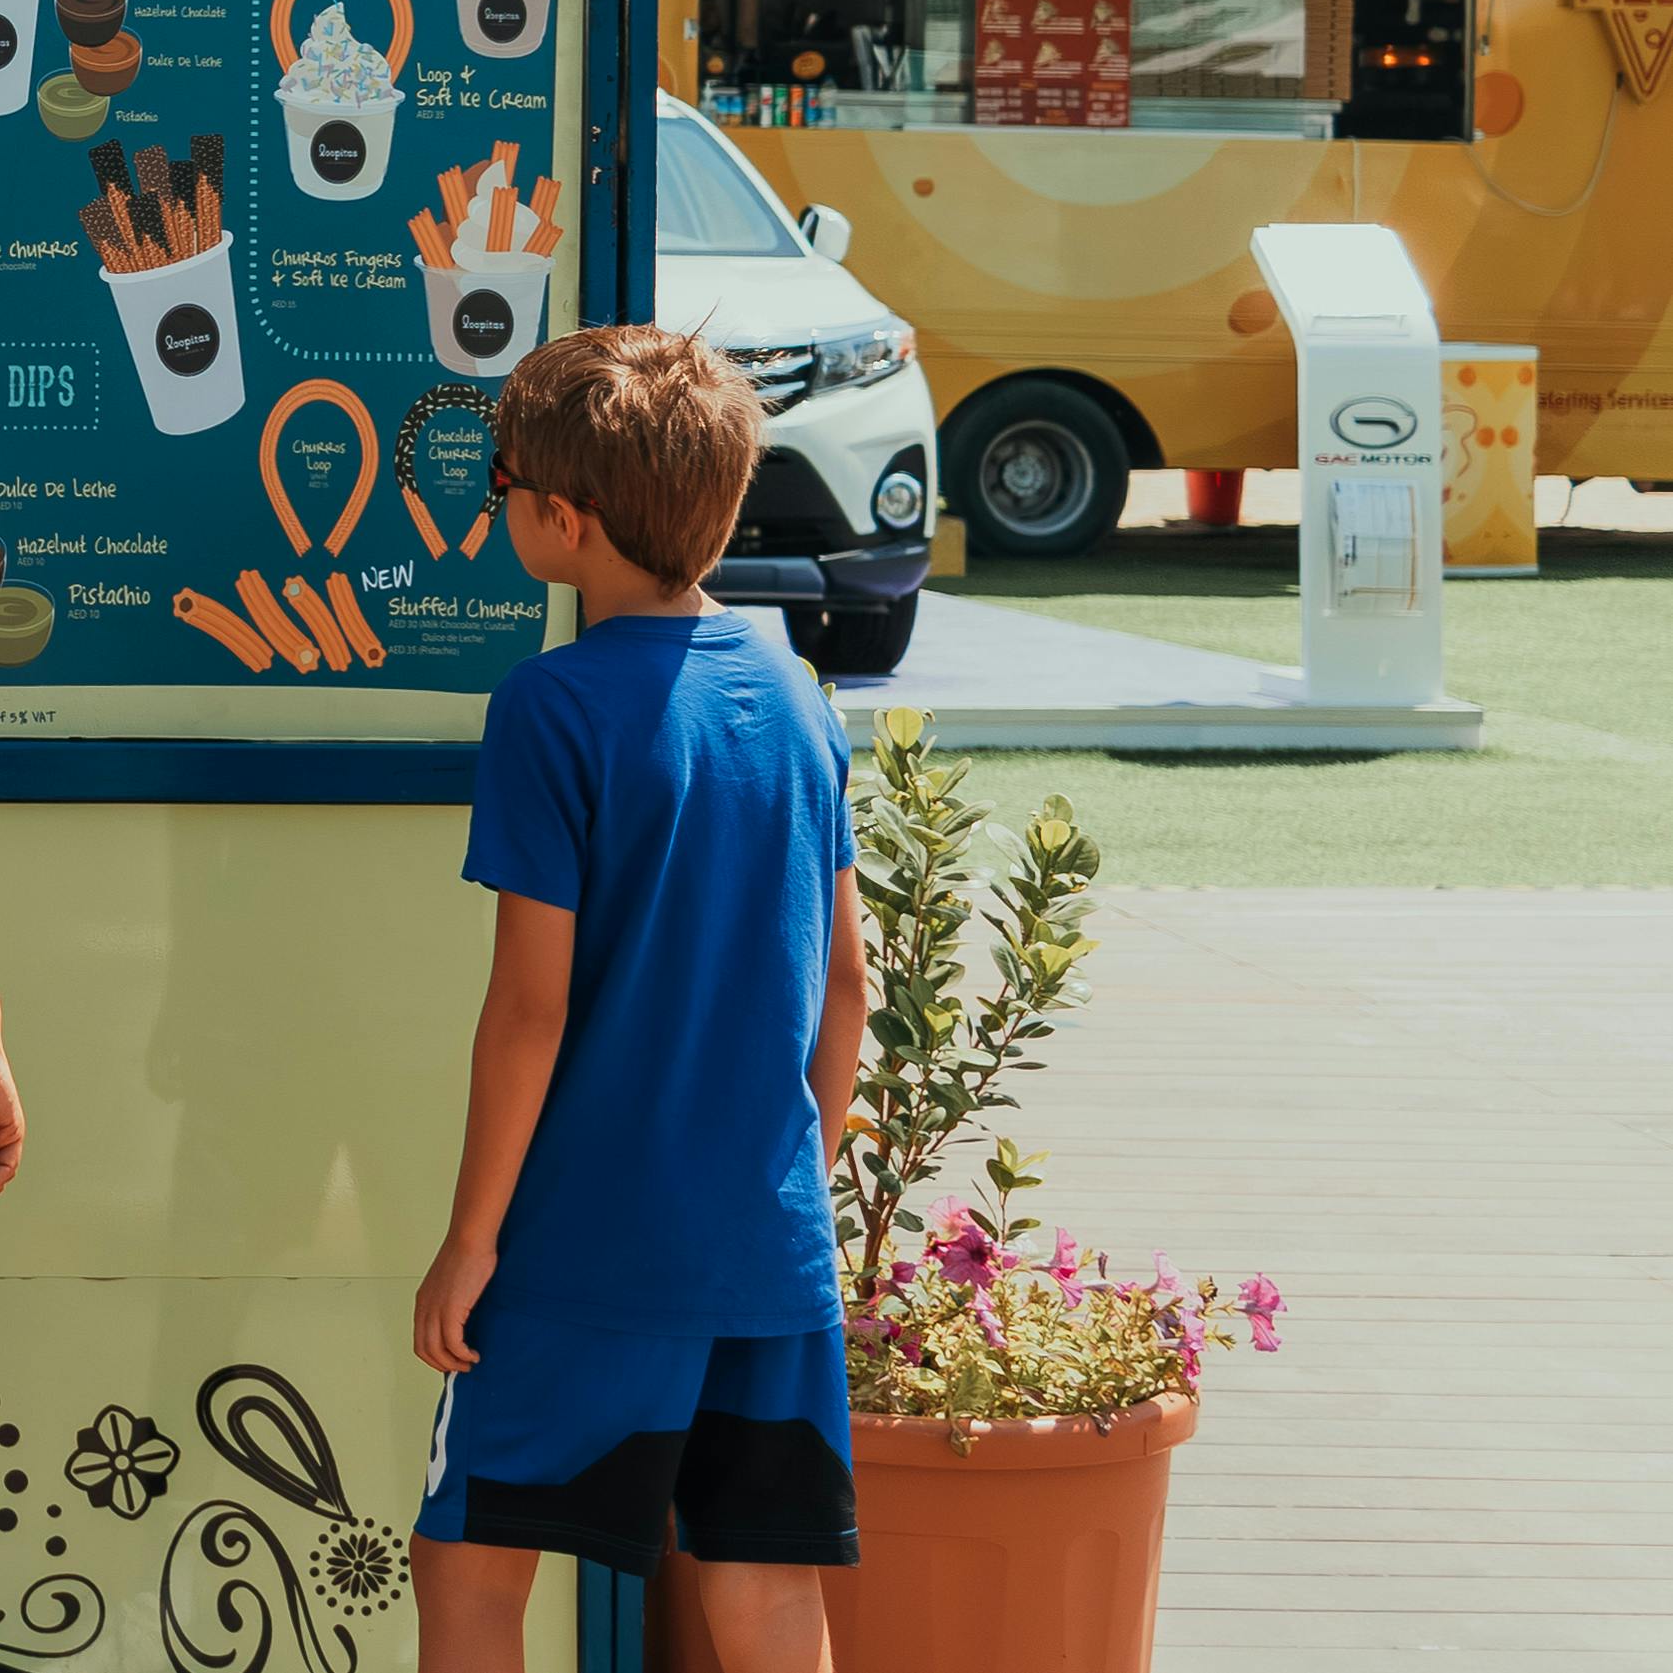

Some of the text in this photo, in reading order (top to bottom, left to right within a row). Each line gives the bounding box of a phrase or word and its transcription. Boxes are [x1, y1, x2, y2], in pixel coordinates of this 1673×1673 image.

[417, 63, 452, 90] Loop
[417, 86, 452, 105] Soft
[489, 90, 546, 109] Cream
[273, 249, 401, 275] Churros Fingers
[293, 270, 323, 286] Soft
[355, 269, 405, 289] Cream
[165, 335, 210, 350] loopitas
[8, 365, 74, 407] DIPS
[429, 428, 482, 443] Chocolate
[306, 453, 331, 473] Loop
[1315, 453, 1432, 465] GAC MOTOR
[443, 462, 467, 480] Loop
[45, 483, 64, 497] De
[73, 478, 116, 498] Leche
[17, 533, 167, 554] Hazelnut Chocolate
[362, 560, 413, 591] NEW
[69, 582, 150, 605] Pistachio
[389, 597, 542, 619] Stuffed Churros
[32, 711, 56, 723] VAT
